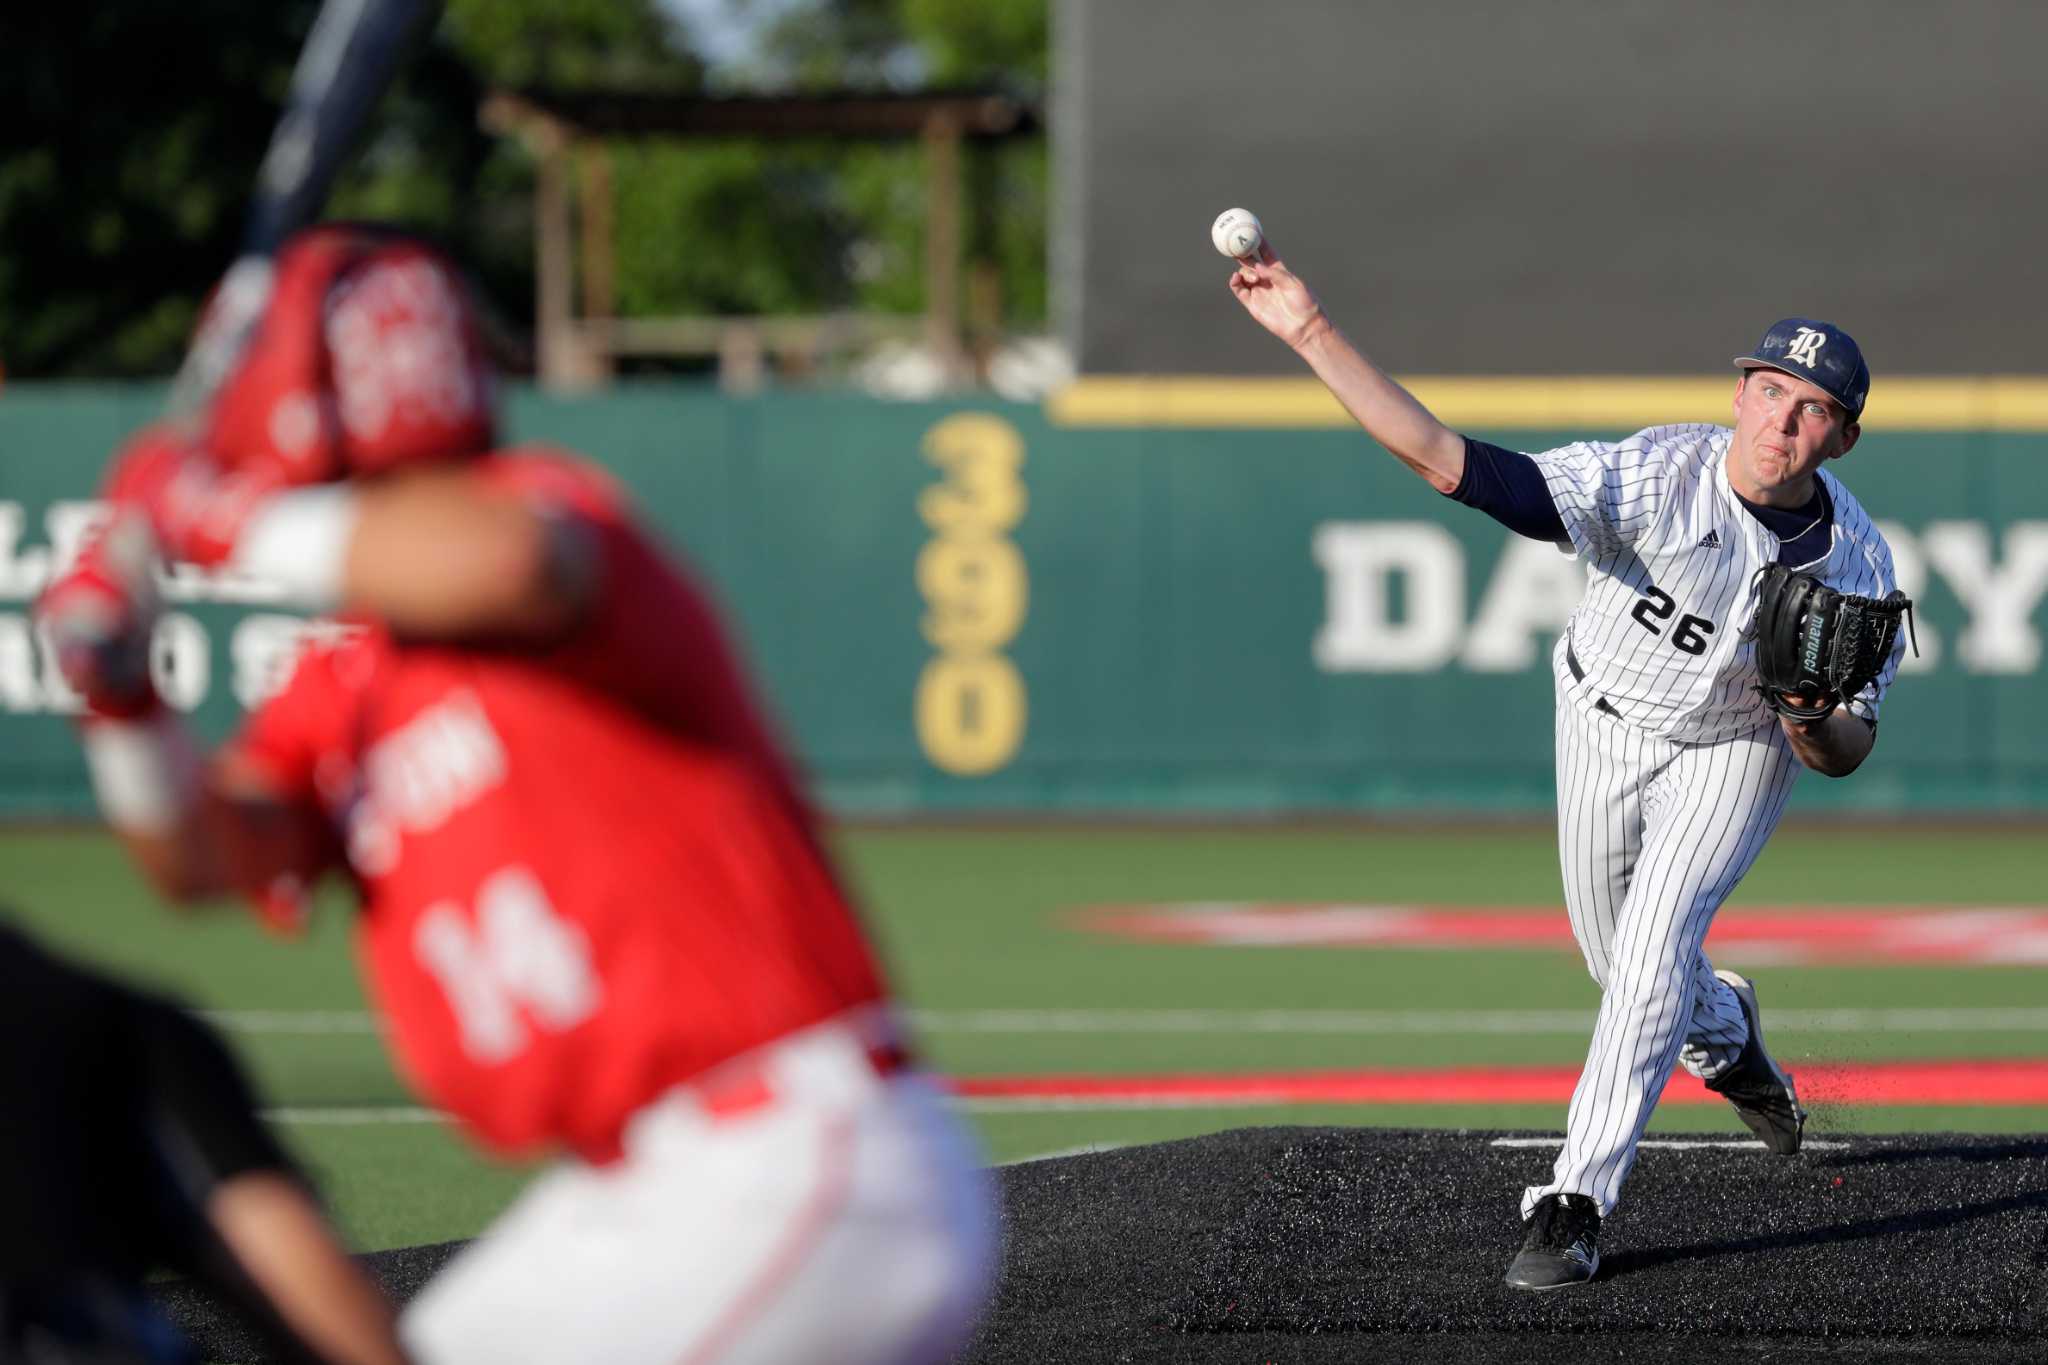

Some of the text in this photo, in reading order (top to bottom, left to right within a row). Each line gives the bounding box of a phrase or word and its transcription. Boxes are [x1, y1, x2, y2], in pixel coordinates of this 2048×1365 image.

[914, 412, 1030, 777] 390
[1311, 519, 2048, 675] DAY
[1631, 585, 1715, 655] 26
[1804, 614, 1825, 676] marucci
[413, 864, 603, 1065] 14
